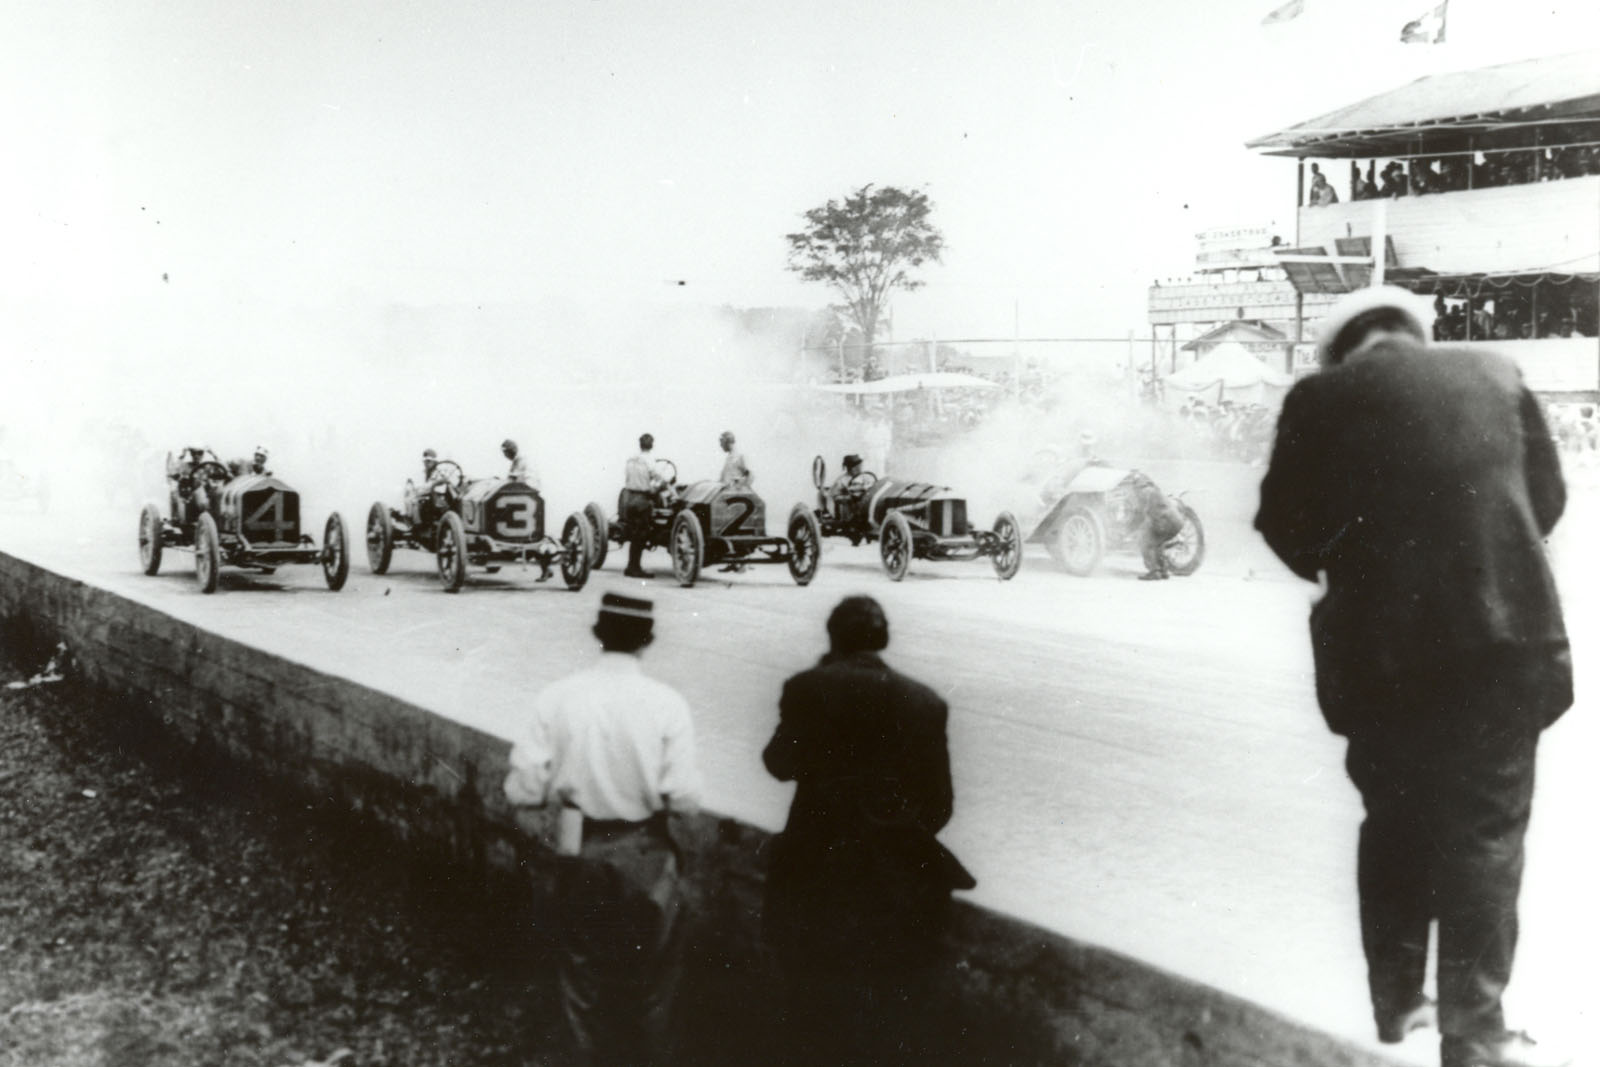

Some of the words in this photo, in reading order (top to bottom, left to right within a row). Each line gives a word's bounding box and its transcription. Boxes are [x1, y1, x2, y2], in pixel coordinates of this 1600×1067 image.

[243, 491, 294, 541] 4
[495, 495, 537, 537] 3
[717, 496, 756, 537] 2
